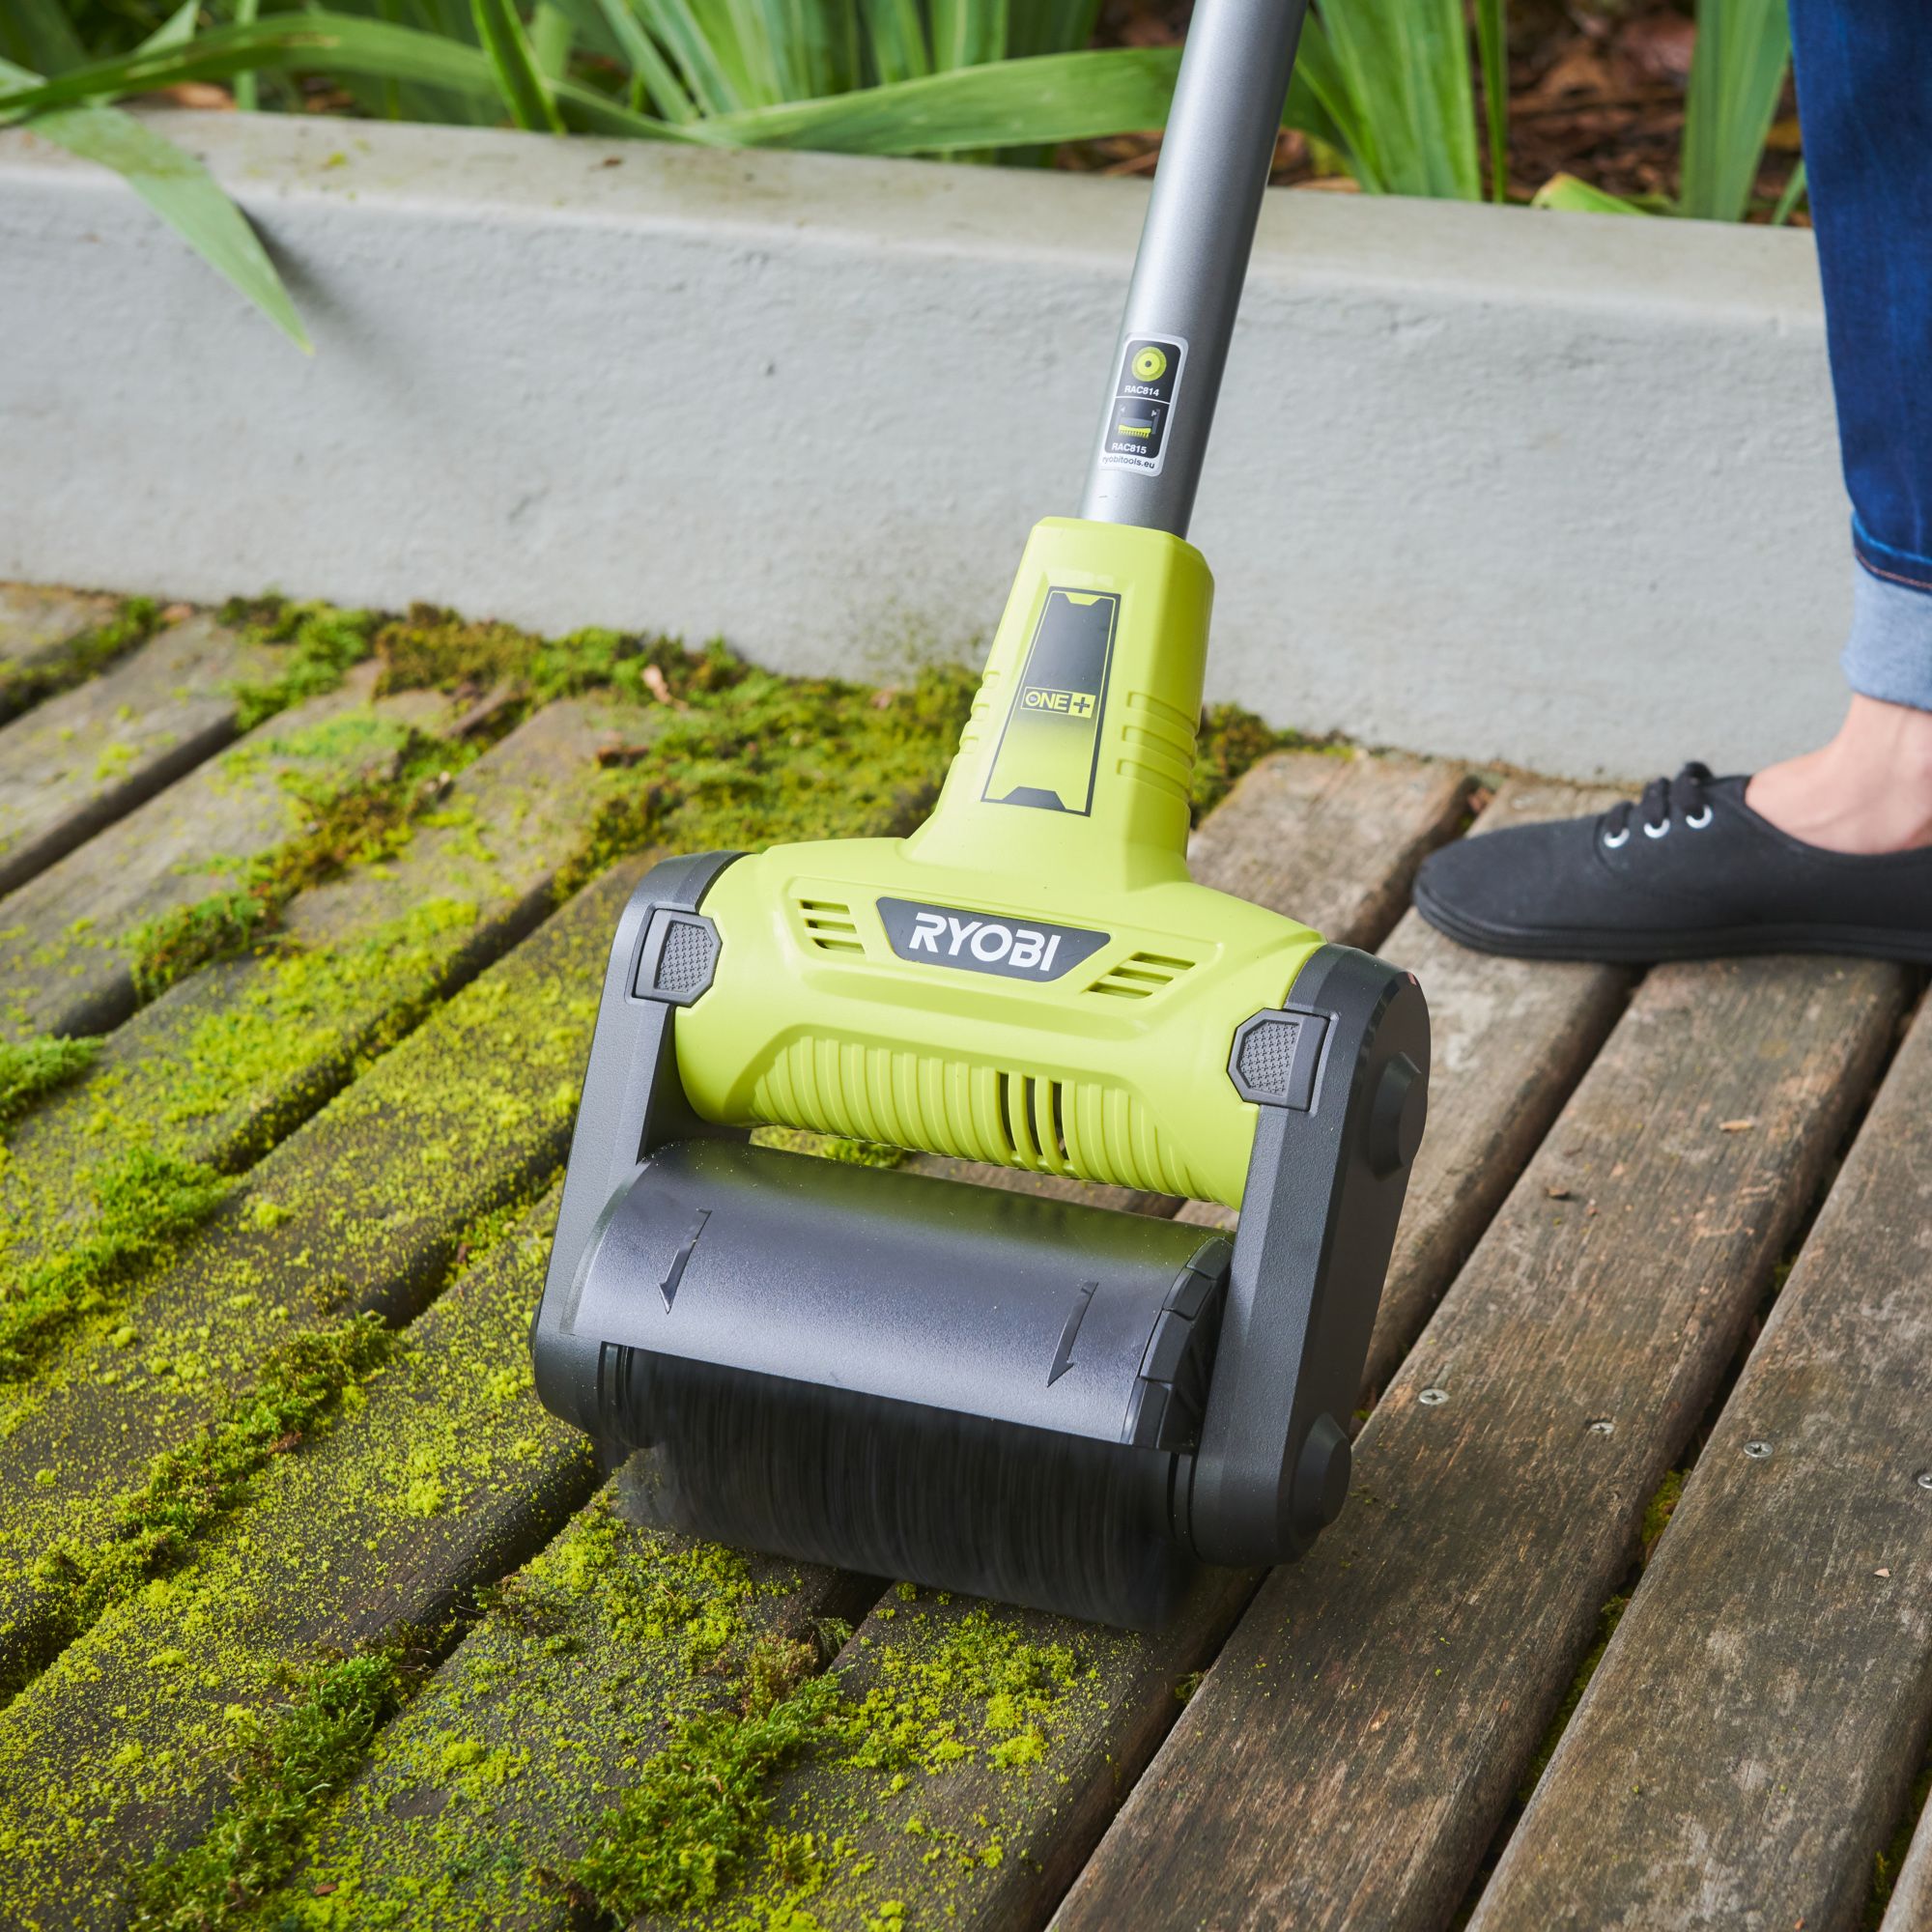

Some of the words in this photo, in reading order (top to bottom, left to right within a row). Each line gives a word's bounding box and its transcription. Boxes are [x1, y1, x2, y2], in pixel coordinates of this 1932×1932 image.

[1124, 384, 1159, 396] RAC814
[1111, 442, 1147, 454] RAC815
[909, 912, 1062, 972] RYOBI
